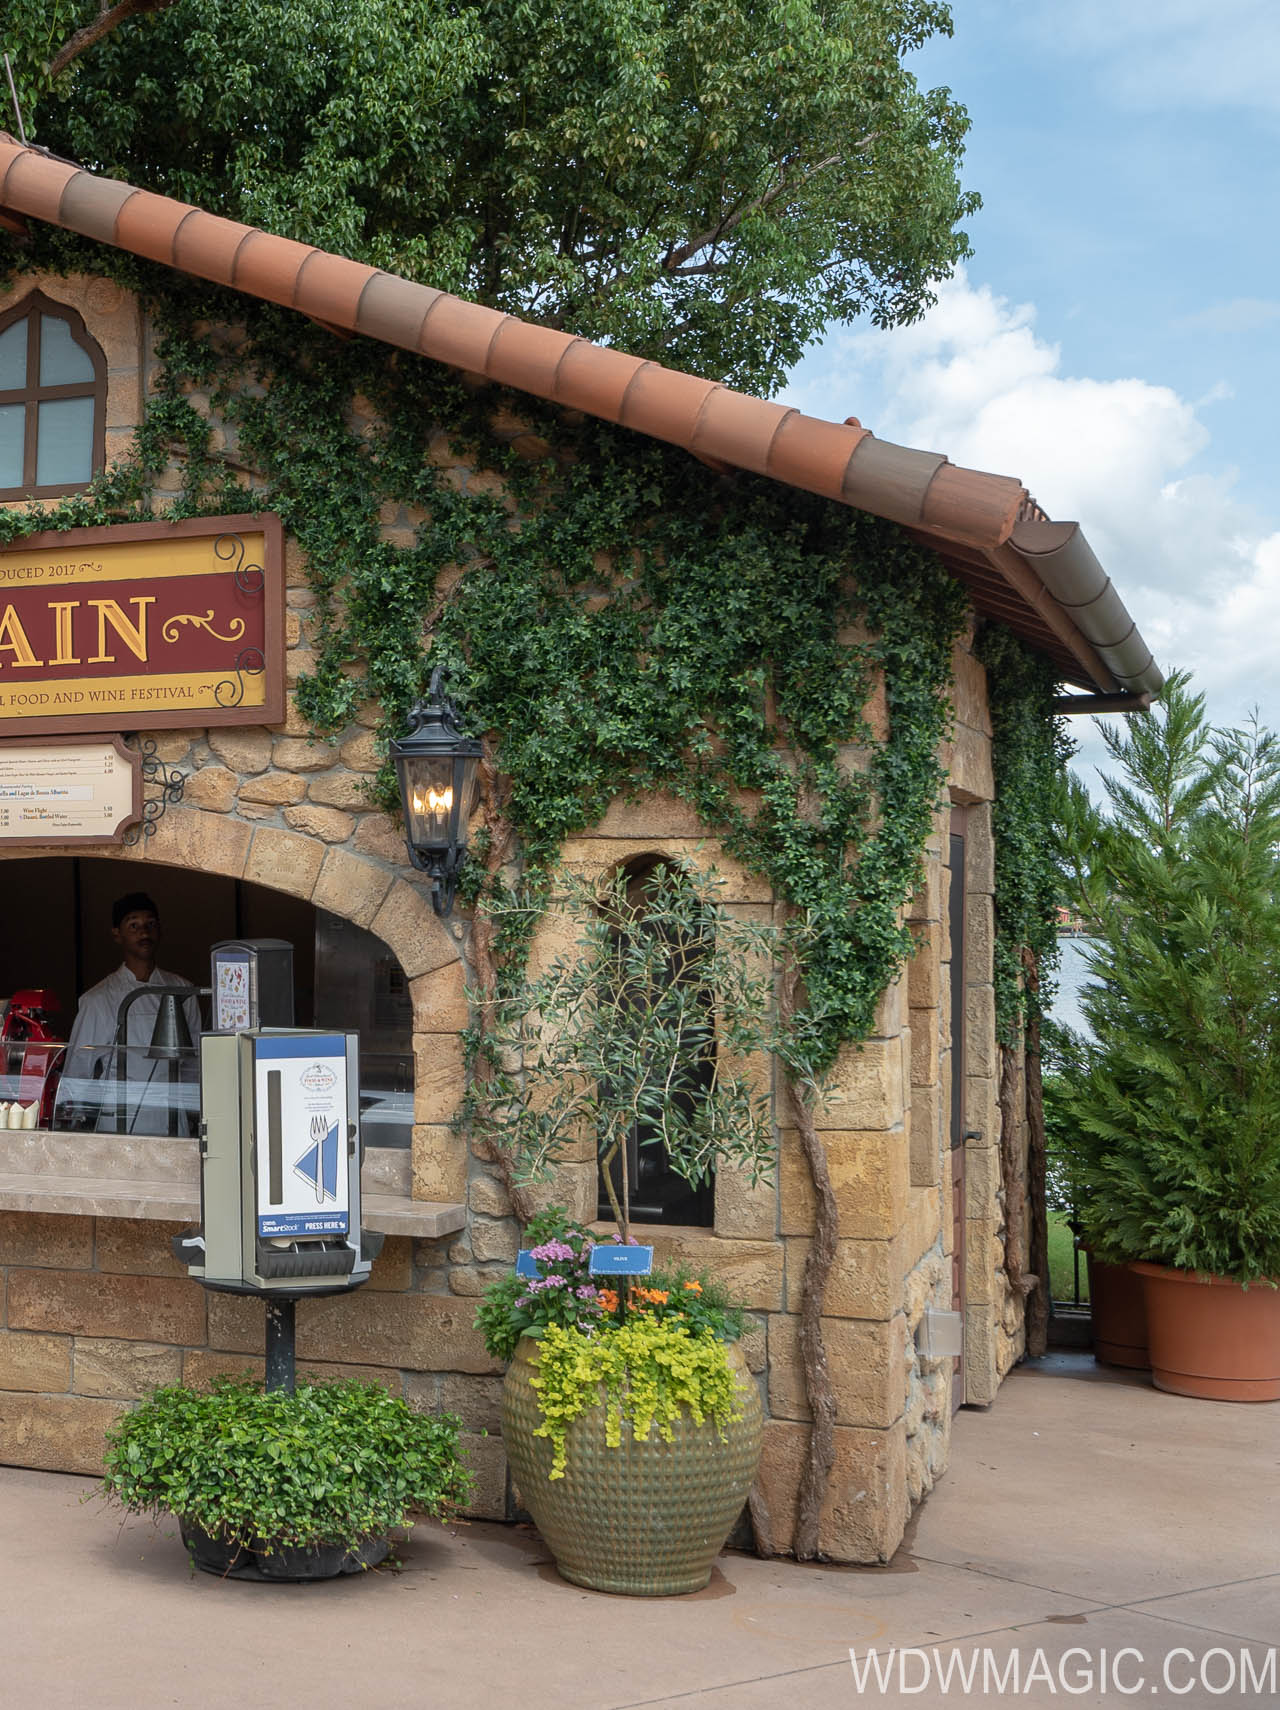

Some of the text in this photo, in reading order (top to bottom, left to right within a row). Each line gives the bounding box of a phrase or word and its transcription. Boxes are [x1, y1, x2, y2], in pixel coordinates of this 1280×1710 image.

[48, 565, 77, 577] 2017
[10, 693, 50, 706] FOOD
[53, 692, 85, 704] AND
[88, 690, 126, 702] WINE
[131, 687, 194, 700] FESTIVAL
[304, 1221, 339, 1230] PRESS HERE
